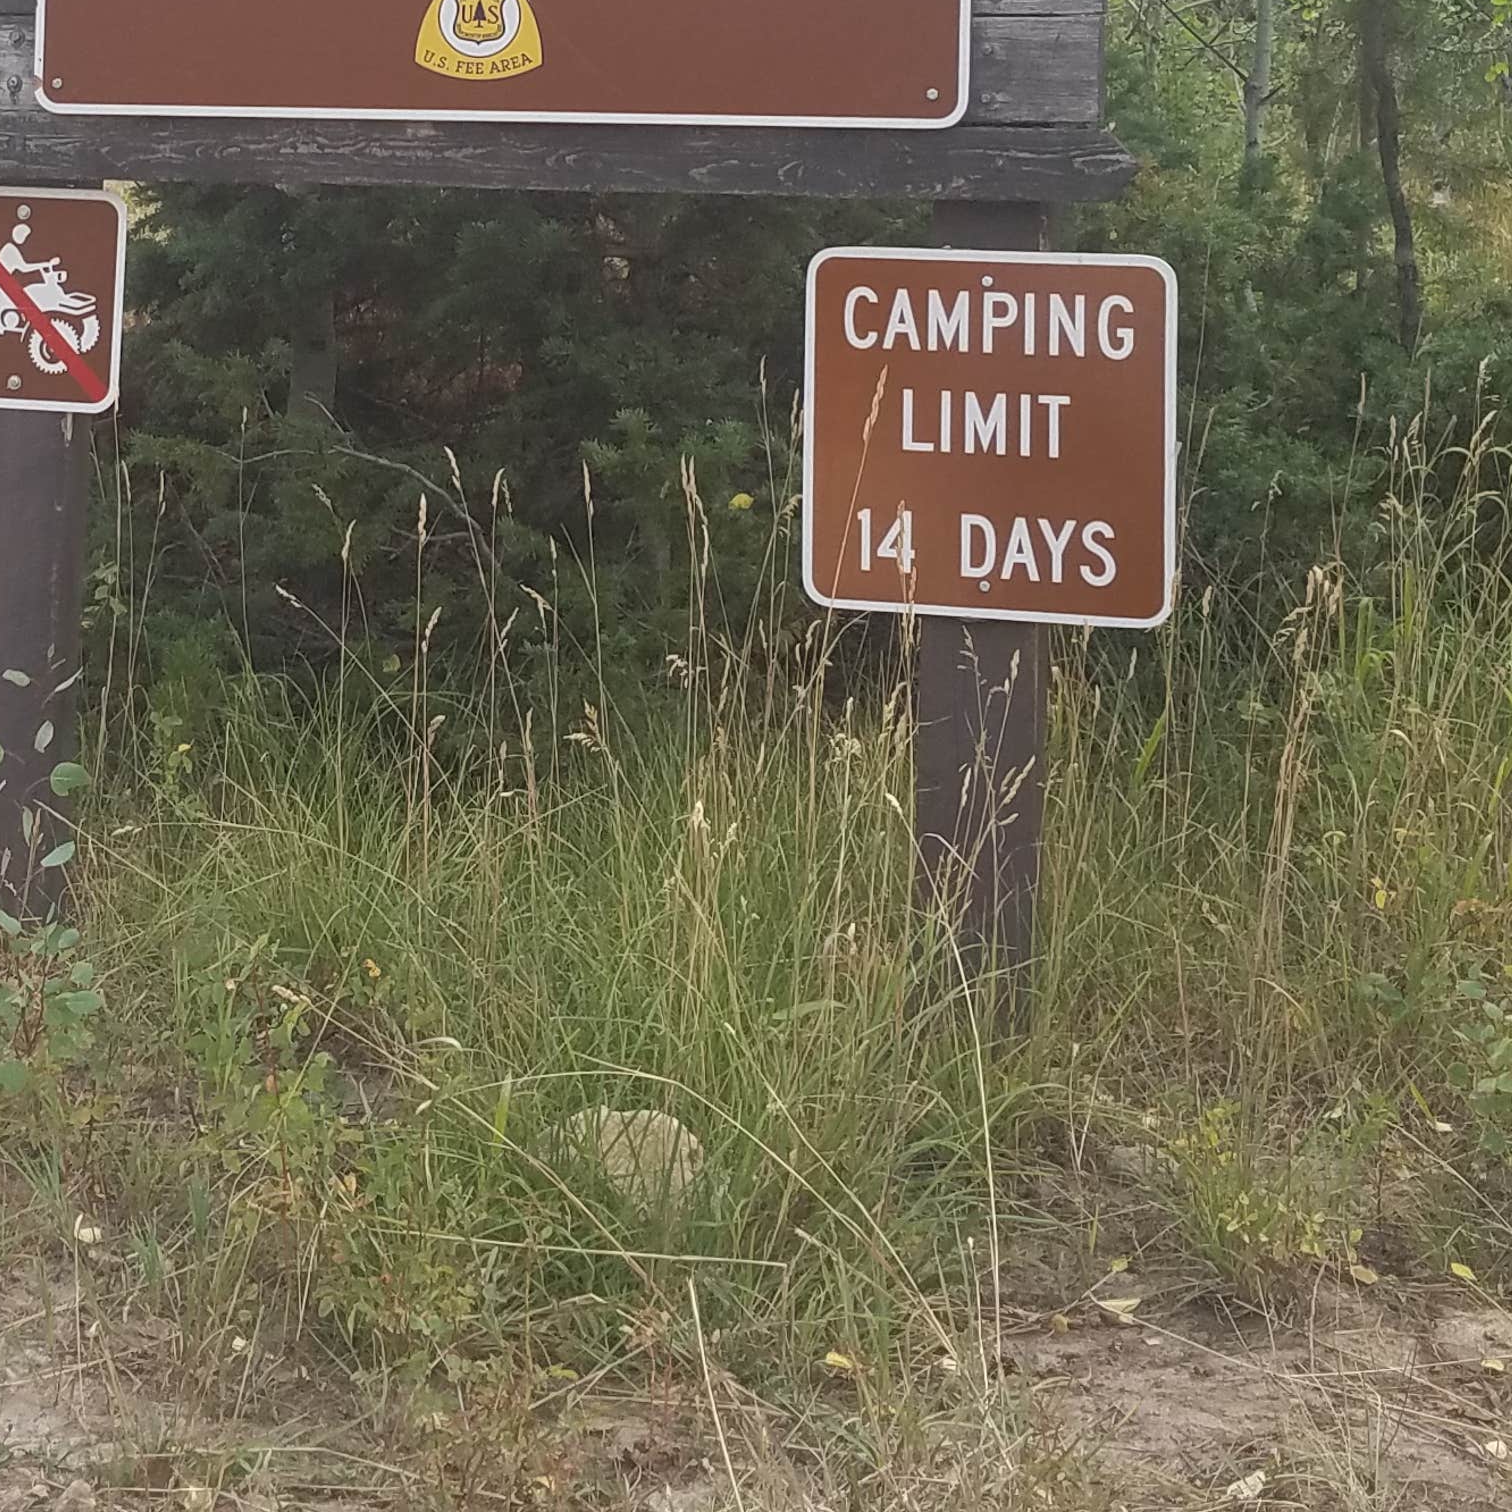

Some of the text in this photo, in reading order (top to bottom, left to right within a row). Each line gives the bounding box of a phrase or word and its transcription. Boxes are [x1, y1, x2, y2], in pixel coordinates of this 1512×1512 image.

[423, 49, 533, 75] U.S. FEE AREA
[844, 287, 1135, 360] CAMPING
[902, 389, 1071, 459] LIMIT
[857, 508, 1117, 587] 14 DAYS
